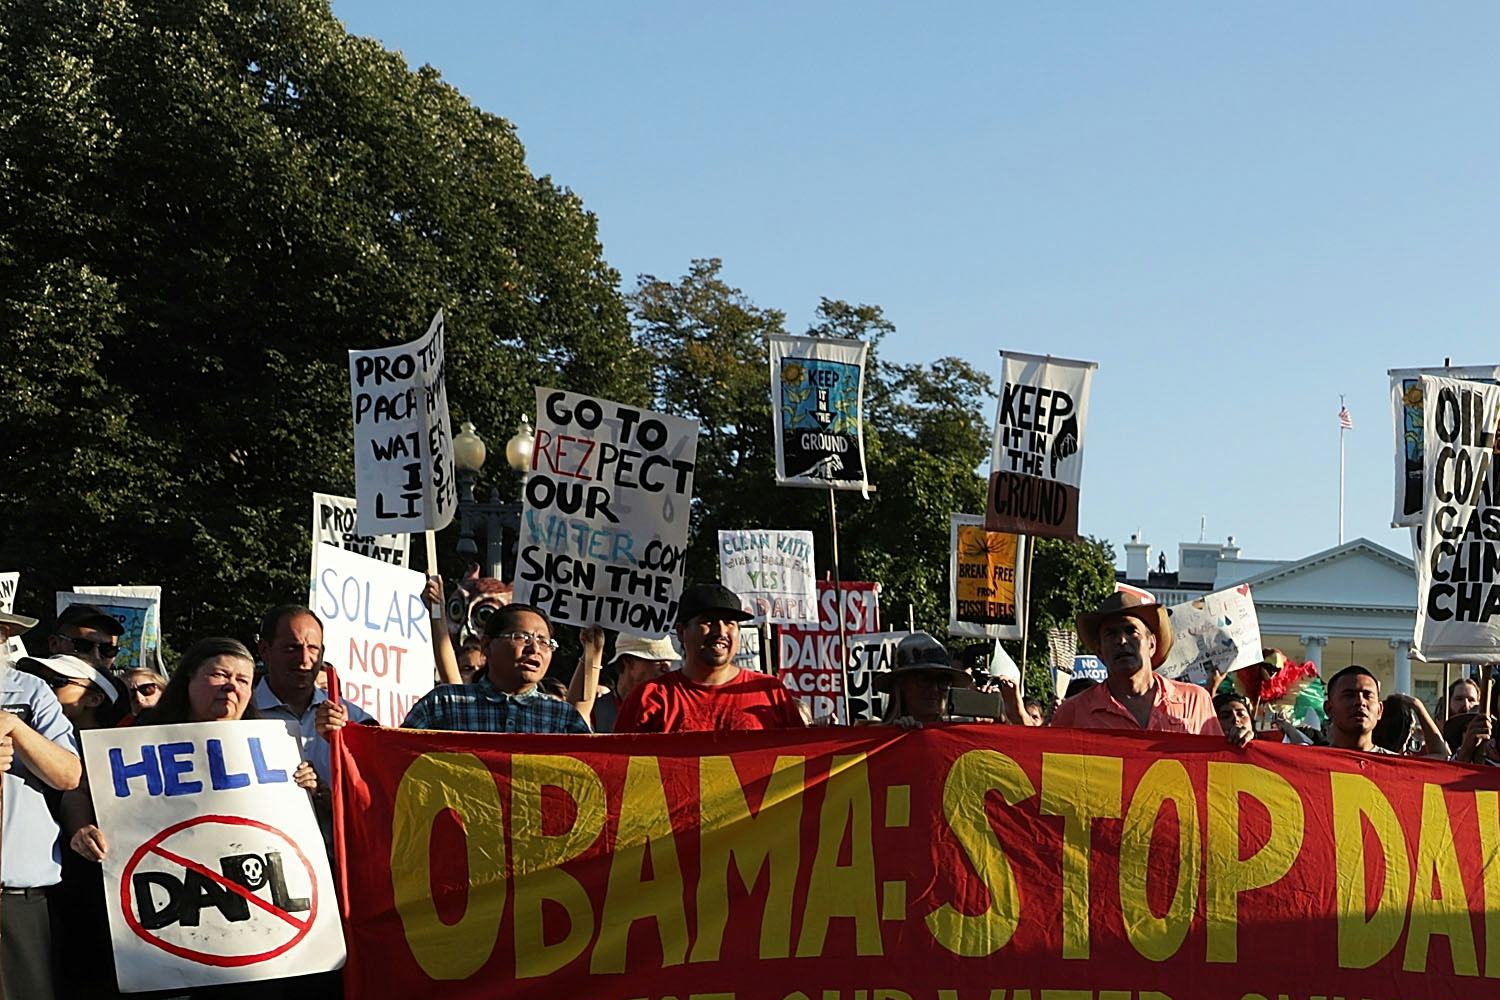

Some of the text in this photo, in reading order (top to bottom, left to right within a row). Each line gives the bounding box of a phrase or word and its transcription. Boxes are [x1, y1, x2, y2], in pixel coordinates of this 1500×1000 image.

[807, 369, 840, 388] KEEP
[818, 390, 827, 400] IT
[546, 392, 668, 451] GO TO
[815, 412, 831, 424] THE
[818, 401, 827, 411] IN
[999, 382, 1074, 435] KEEP
[1435, 387, 1494, 448] OIL
[532, 429, 694, 494] REZPECT
[801, 433, 848, 453] GROUND
[1002, 427, 1047, 455] IT IN
[1008, 448, 1044, 477] THE
[525, 475, 620, 523] OUR
[994, 473, 1067, 526] GROUND
[526, 509, 638, 564] WATER
[723, 532, 770, 555] CLEAN
[520, 545, 672, 603] SIGN THE
[959, 563, 1014, 583] BREAK FREE
[976, 587, 996, 598] FROM
[320, 568, 428, 643] SOLAR
[530, 583, 679, 633] PETITION!
[988, 601, 1015, 618] FUELS
[349, 637, 408, 684] NOT
[1070, 669, 1107, 680] DAKOT
[1081, 659, 1098, 669] NO
[108, 737, 289, 797] HELL
[390, 751, 911, 980] OBAMA:
[923, 749, 1305, 963] STOP
[132, 851, 310, 930] DAPL
